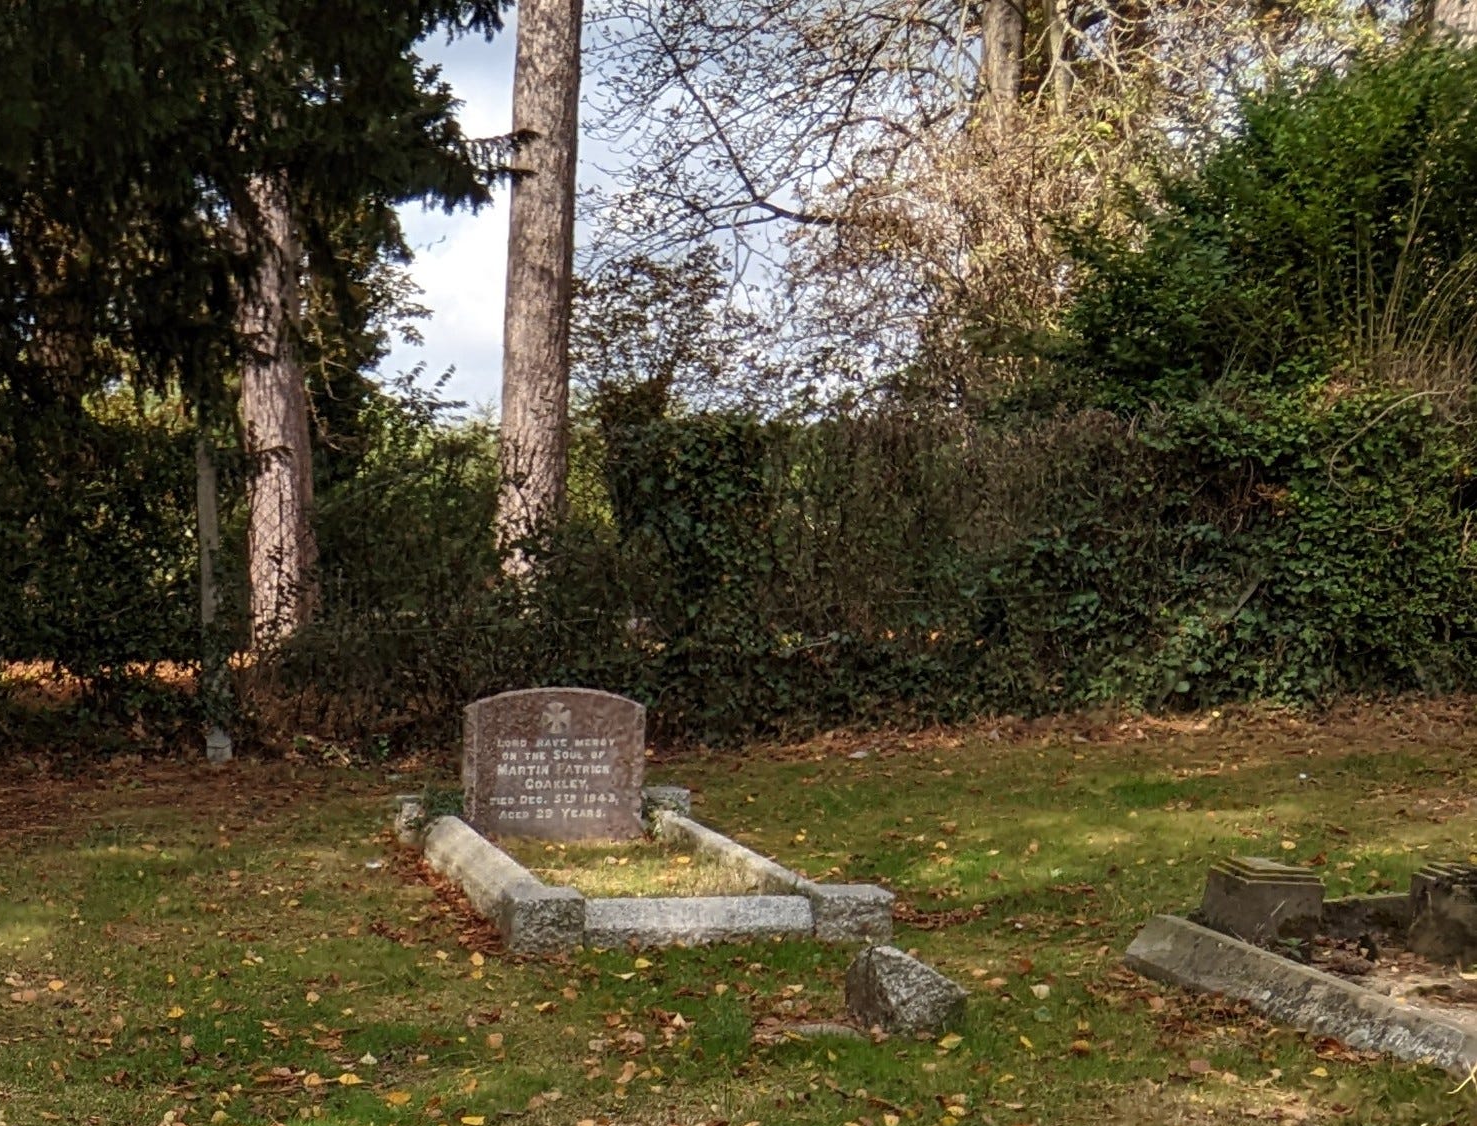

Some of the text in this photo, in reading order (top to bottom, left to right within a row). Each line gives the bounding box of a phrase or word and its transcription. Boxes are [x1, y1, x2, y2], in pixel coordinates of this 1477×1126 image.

[497, 739, 527, 748] LORD
[575, 738, 616, 747] MERCY
[525, 752, 546, 760] THE
[497, 764, 611, 775] MARTIN PATRICK
